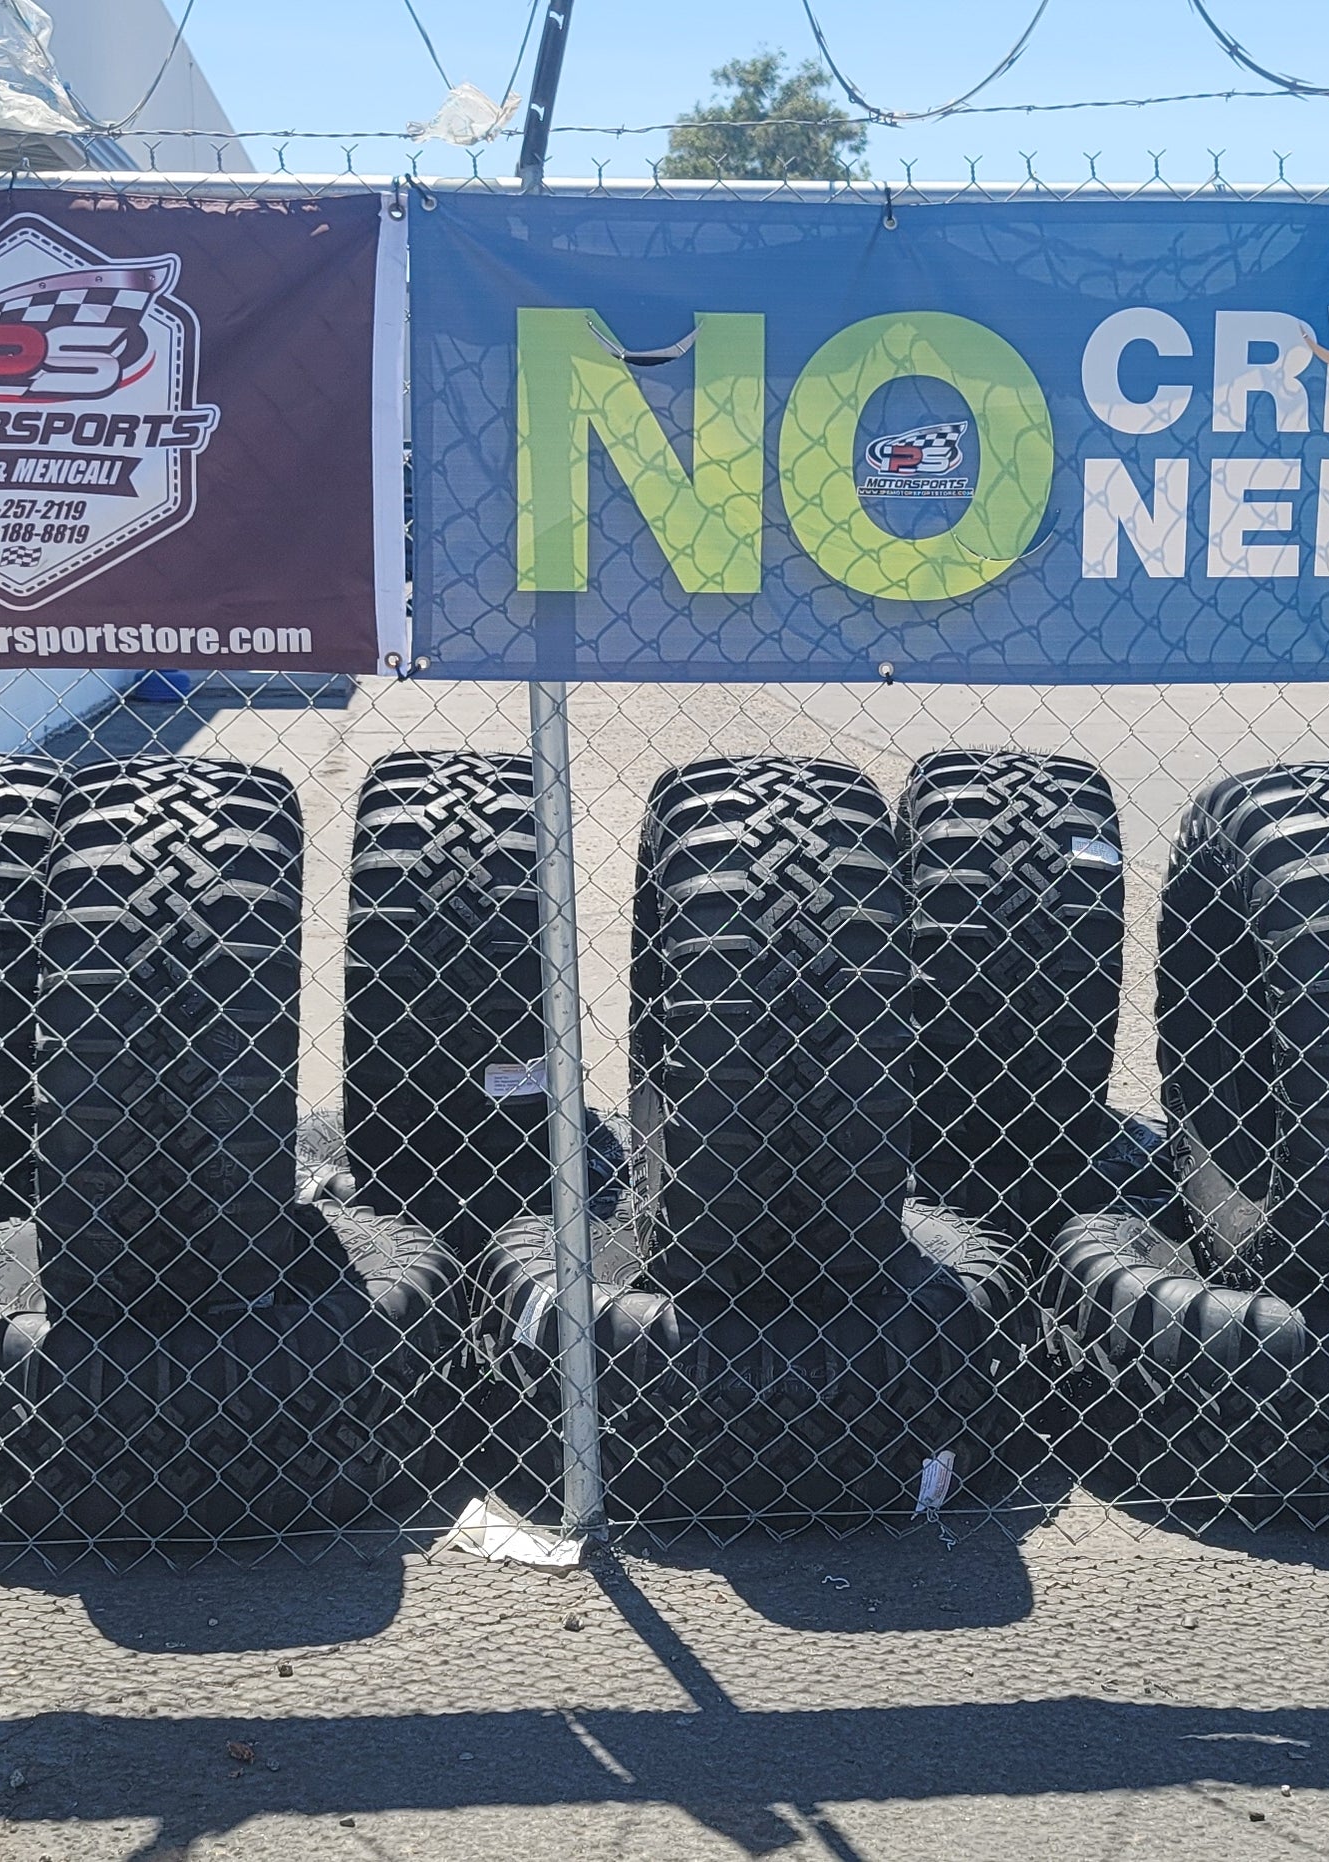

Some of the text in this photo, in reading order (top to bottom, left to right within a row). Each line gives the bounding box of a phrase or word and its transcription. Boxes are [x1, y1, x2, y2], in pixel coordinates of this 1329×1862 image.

[516, 307, 1055, 601] NO
[11, 458, 122, 486] MEXICALI
[866, 478, 967, 488] MOTORSPORTS
